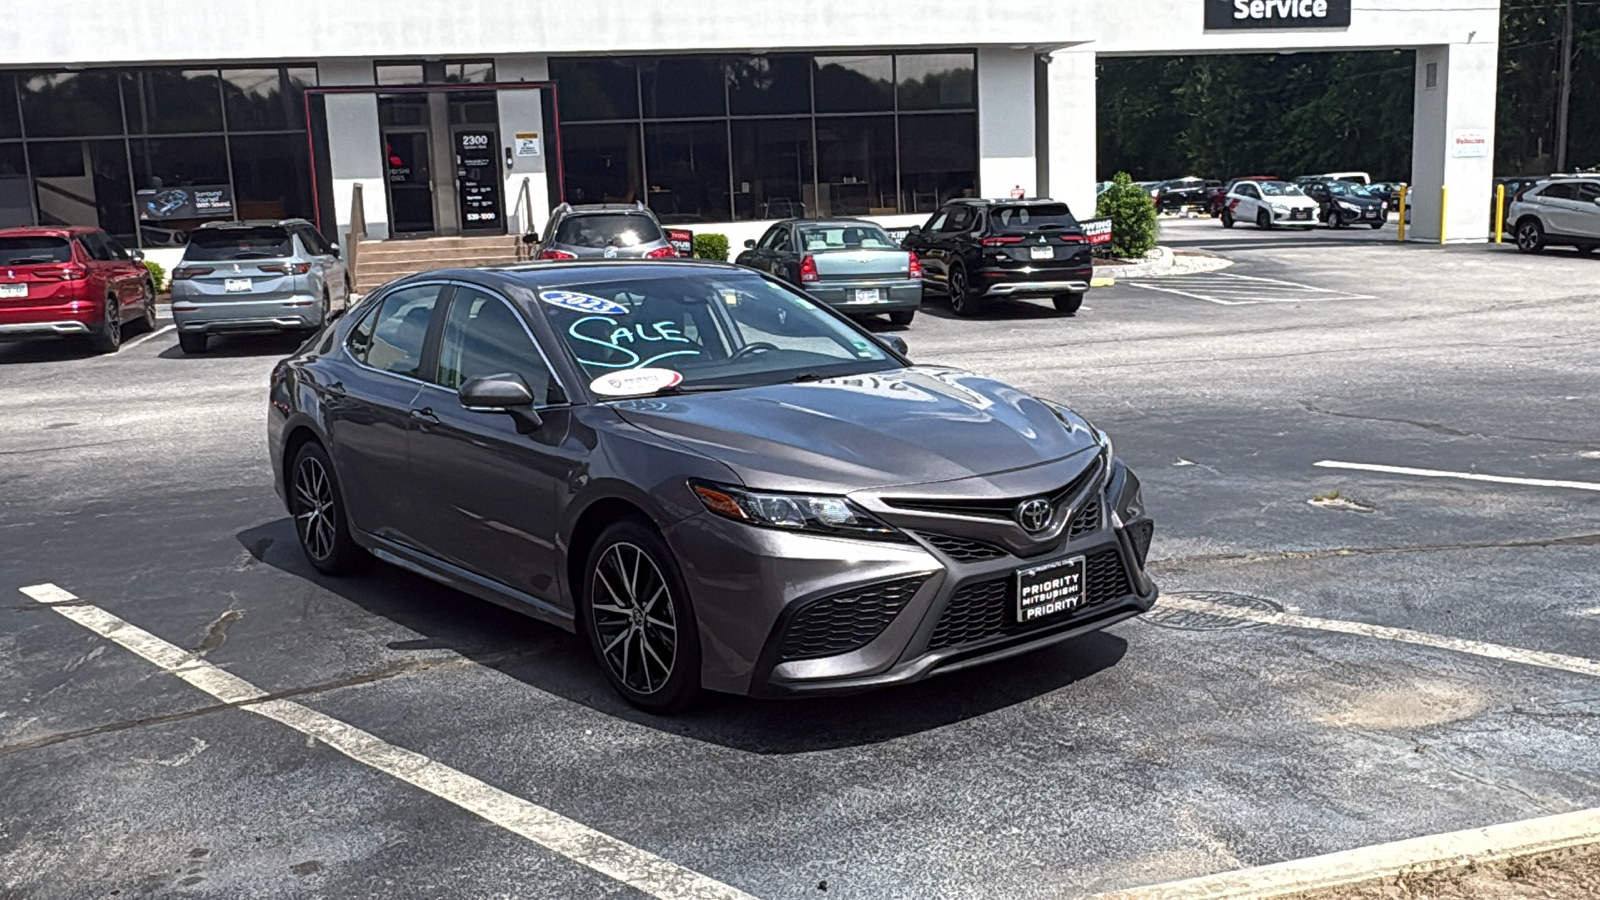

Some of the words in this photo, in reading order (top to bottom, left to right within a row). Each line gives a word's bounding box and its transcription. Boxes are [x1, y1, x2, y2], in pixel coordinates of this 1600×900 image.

[1233, 0, 1328, 19] Service
[462, 135, 488, 146] 2300
[550, 293, 612, 311] 2023
[569, 316, 690, 368] SALE
[1022, 584, 1079, 606] MITSUBISHI
[1023, 574, 1079, 596] PRIORITY
[1027, 596, 1079, 620] PRIORITY
